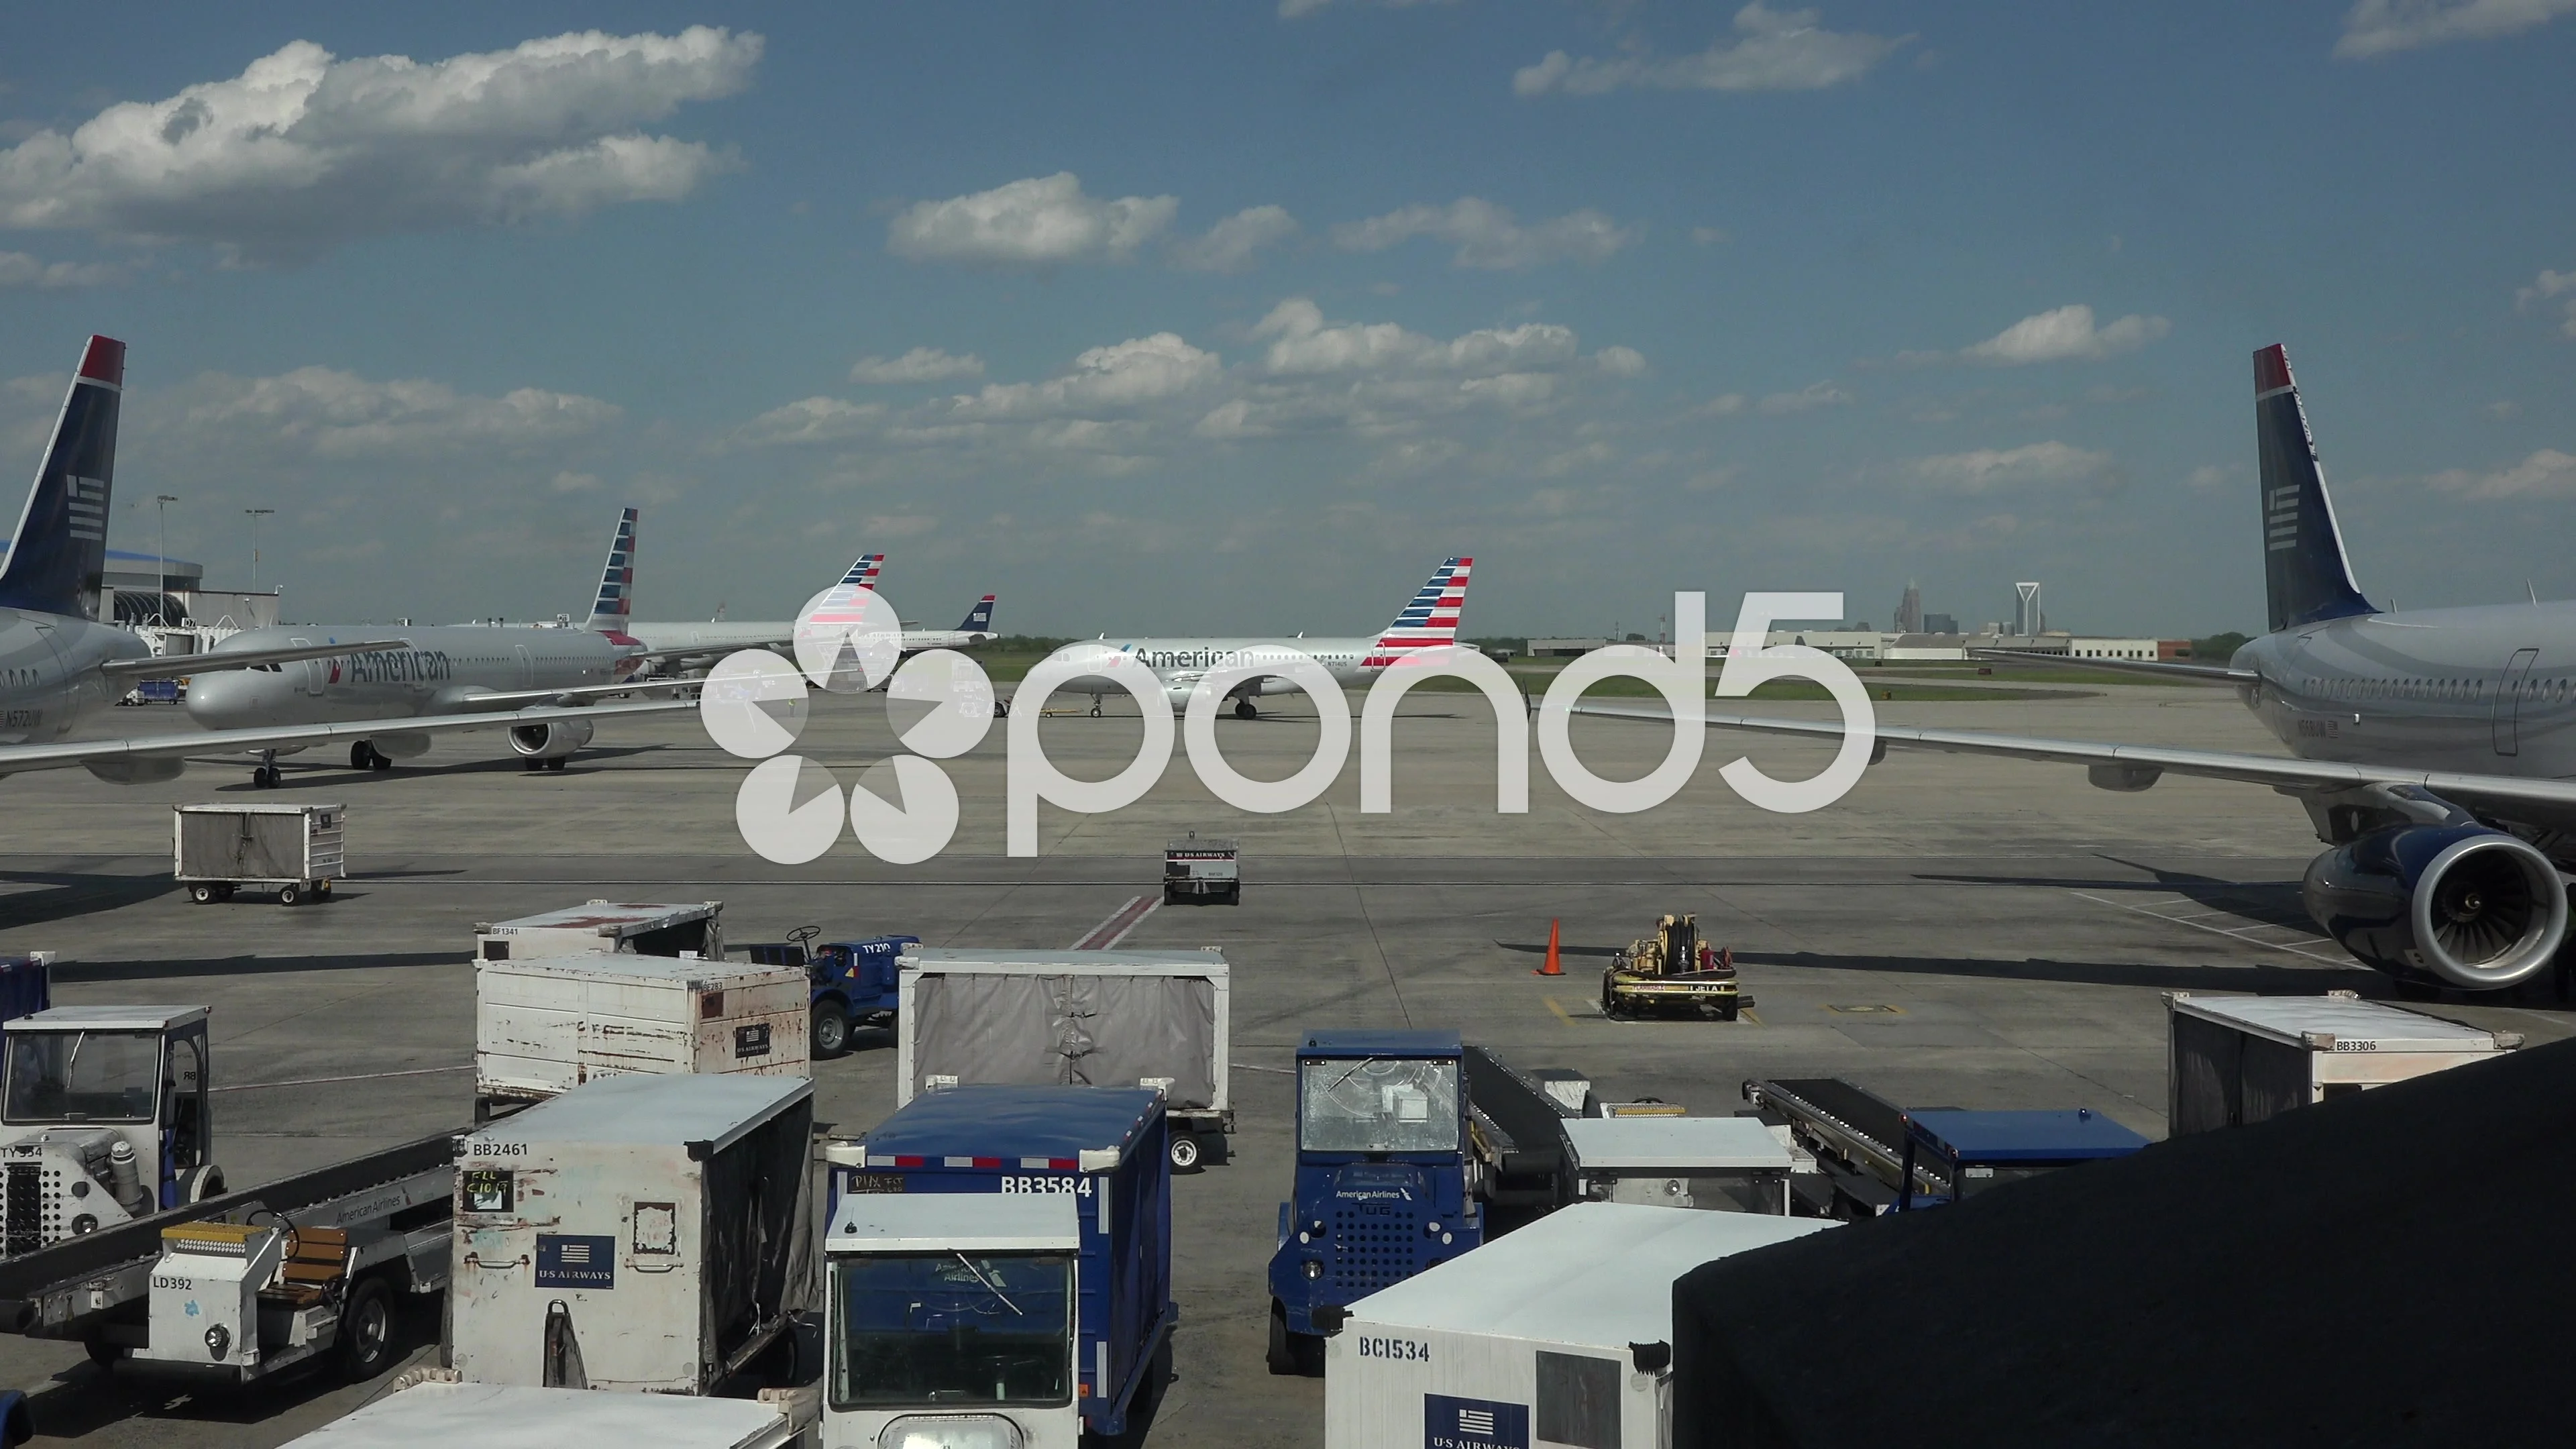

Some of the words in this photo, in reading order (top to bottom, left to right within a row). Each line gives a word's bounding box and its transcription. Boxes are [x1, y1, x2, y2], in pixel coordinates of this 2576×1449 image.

[1132, 646, 1254, 668] American
[350, 651, 451, 683] American
[492, 927, 519, 935] BF1341
[2337, 1040, 2377, 1051] BB3306
[474, 1143, 528, 1156] BB2461
[1001, 1176, 1092, 1197] BB3584
[1336, 1190, 1371, 1199] American
[1372, 1190, 1400, 1199] Airlines
[335, 1205, 372, 1225] American
[372, 1194, 400, 1213] Airlines
[558, 1271, 611, 1280] AIRWAYS
[945, 1273, 980, 1283] Airlines
